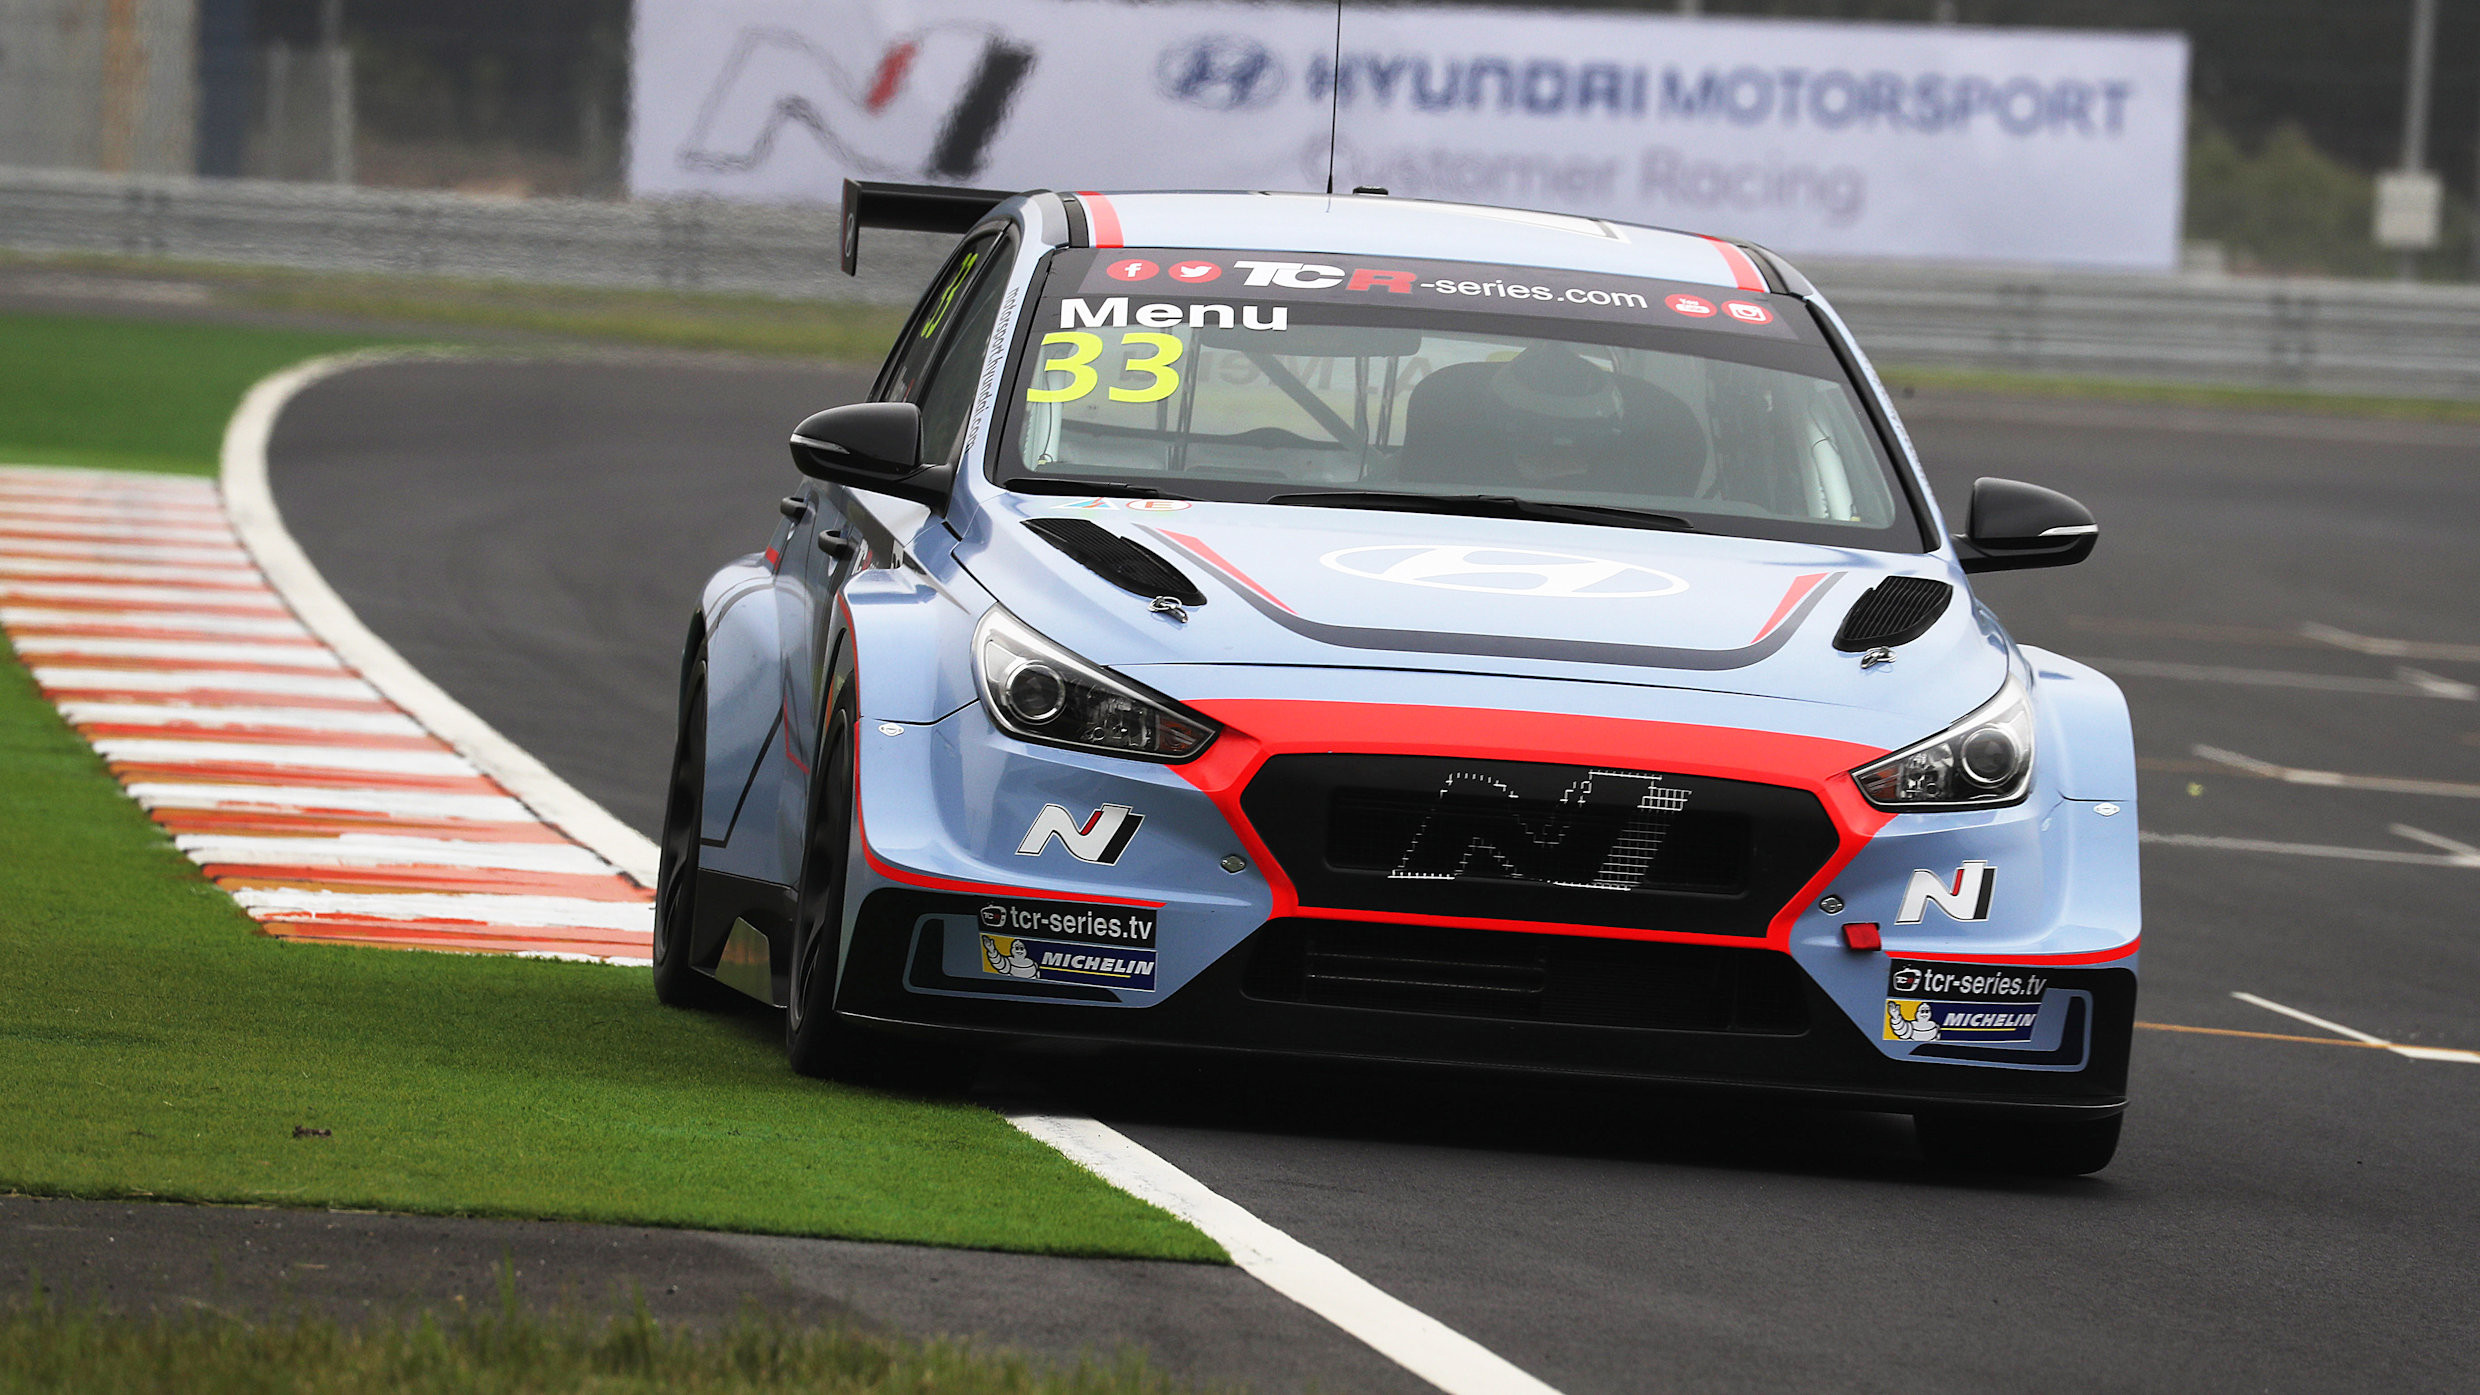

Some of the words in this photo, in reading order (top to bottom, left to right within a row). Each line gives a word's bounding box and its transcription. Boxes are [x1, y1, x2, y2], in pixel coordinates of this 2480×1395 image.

[1308, 51, 1648, 118] HYUNDAI
[1660, 66, 2131, 137] MOTORSPORT
[1640, 145, 1866, 228] Racing
[1060, 297, 1288, 332] Menu
[1026, 331, 1184, 403] 33
[1010, 905, 1153, 940] tcr-series.tv
[1041, 952, 1155, 975] MICHELIN
[1924, 968, 2047, 996] tcr-series.tv
[1942, 1012, 2037, 1027] MICHELIN
